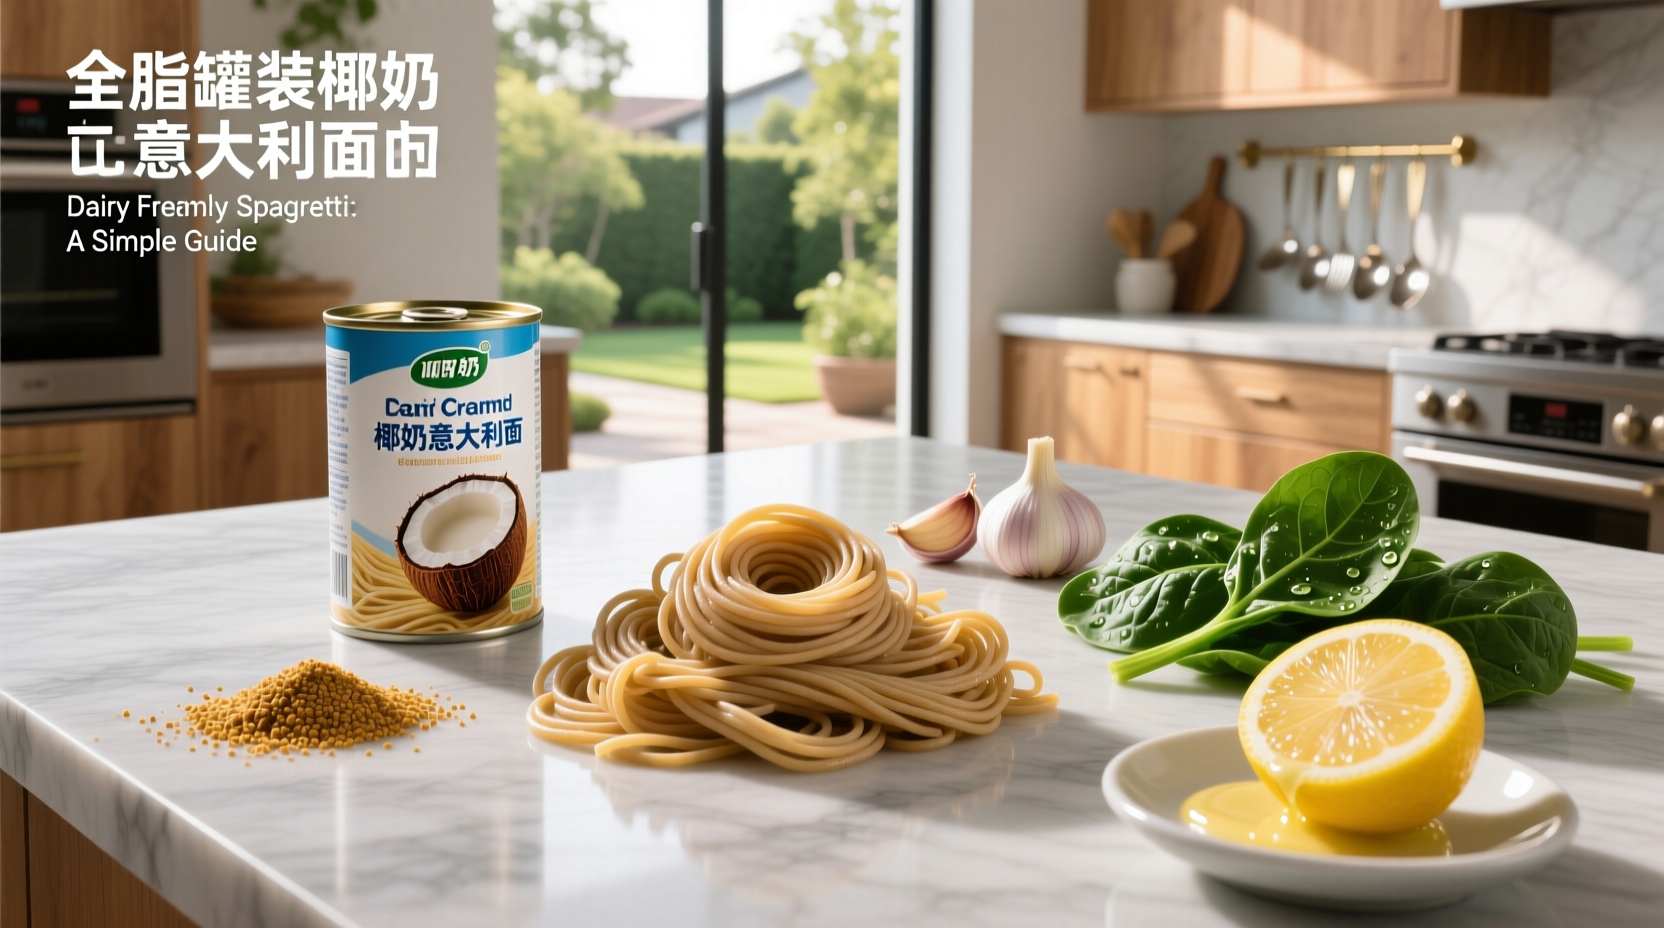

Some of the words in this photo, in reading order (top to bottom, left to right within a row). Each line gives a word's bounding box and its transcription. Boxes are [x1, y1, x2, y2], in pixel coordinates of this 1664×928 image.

[374, 417, 523, 452] 椰奶意大利面
